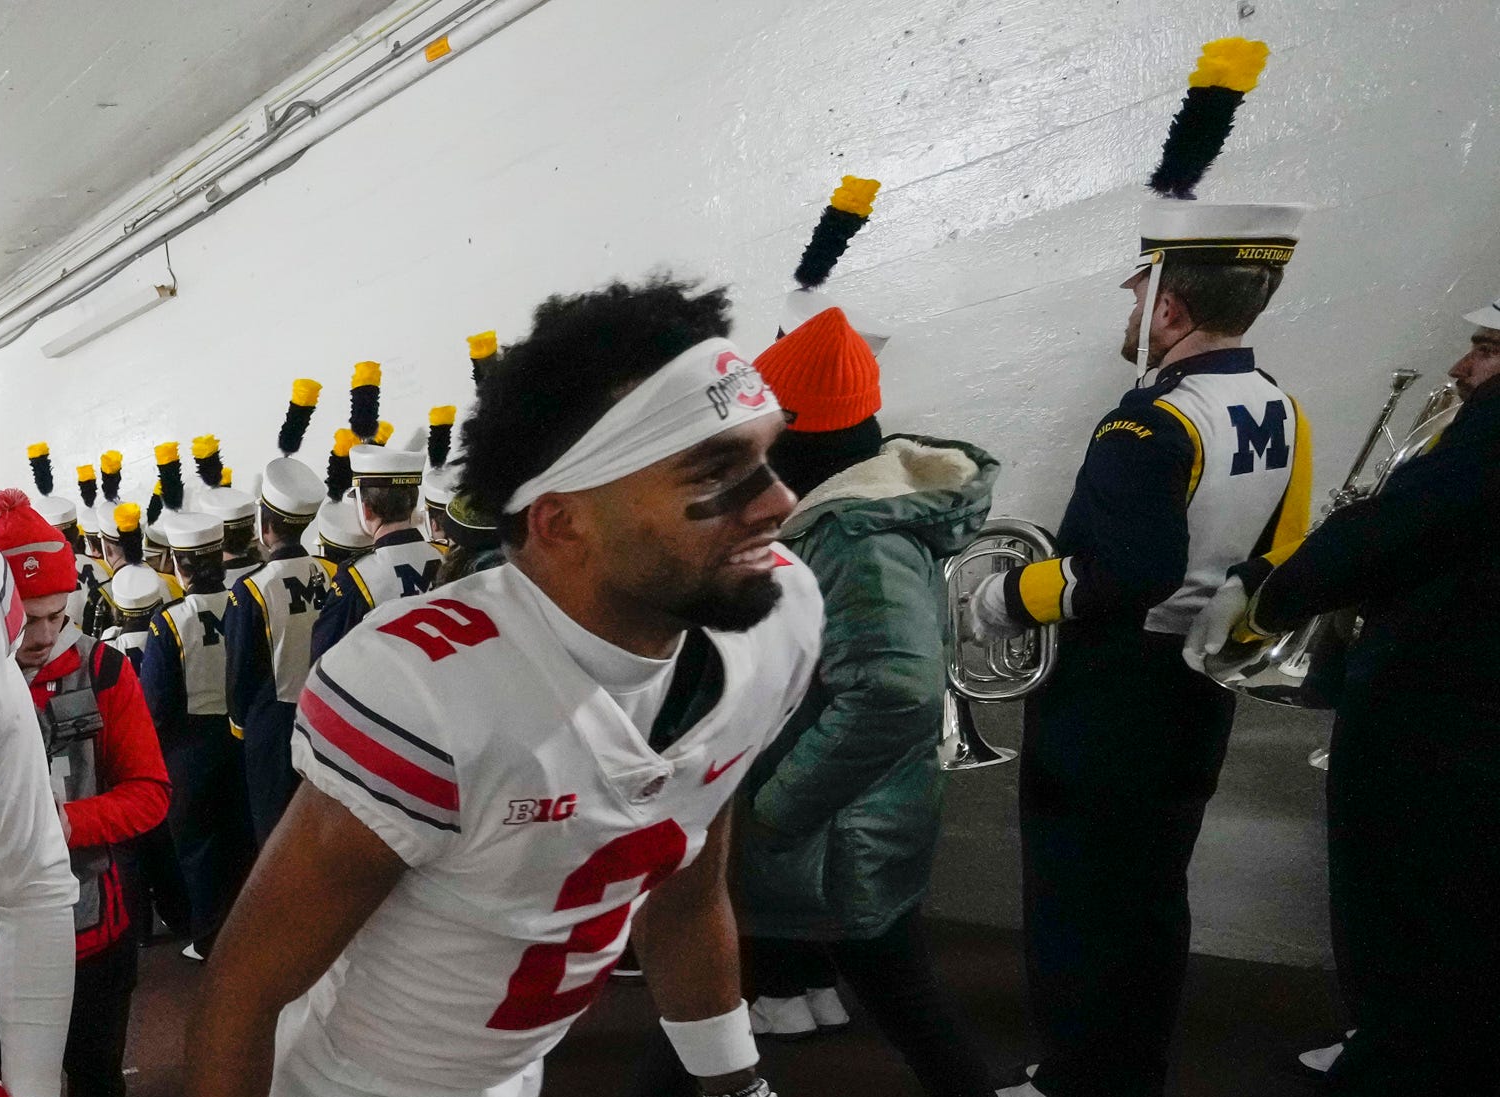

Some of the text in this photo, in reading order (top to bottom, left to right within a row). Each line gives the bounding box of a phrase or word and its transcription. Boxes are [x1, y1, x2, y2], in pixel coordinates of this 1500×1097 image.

[1226, 399, 1290, 477] M
[375, 598, 500, 662] 2
[486, 818, 688, 1031] 2
